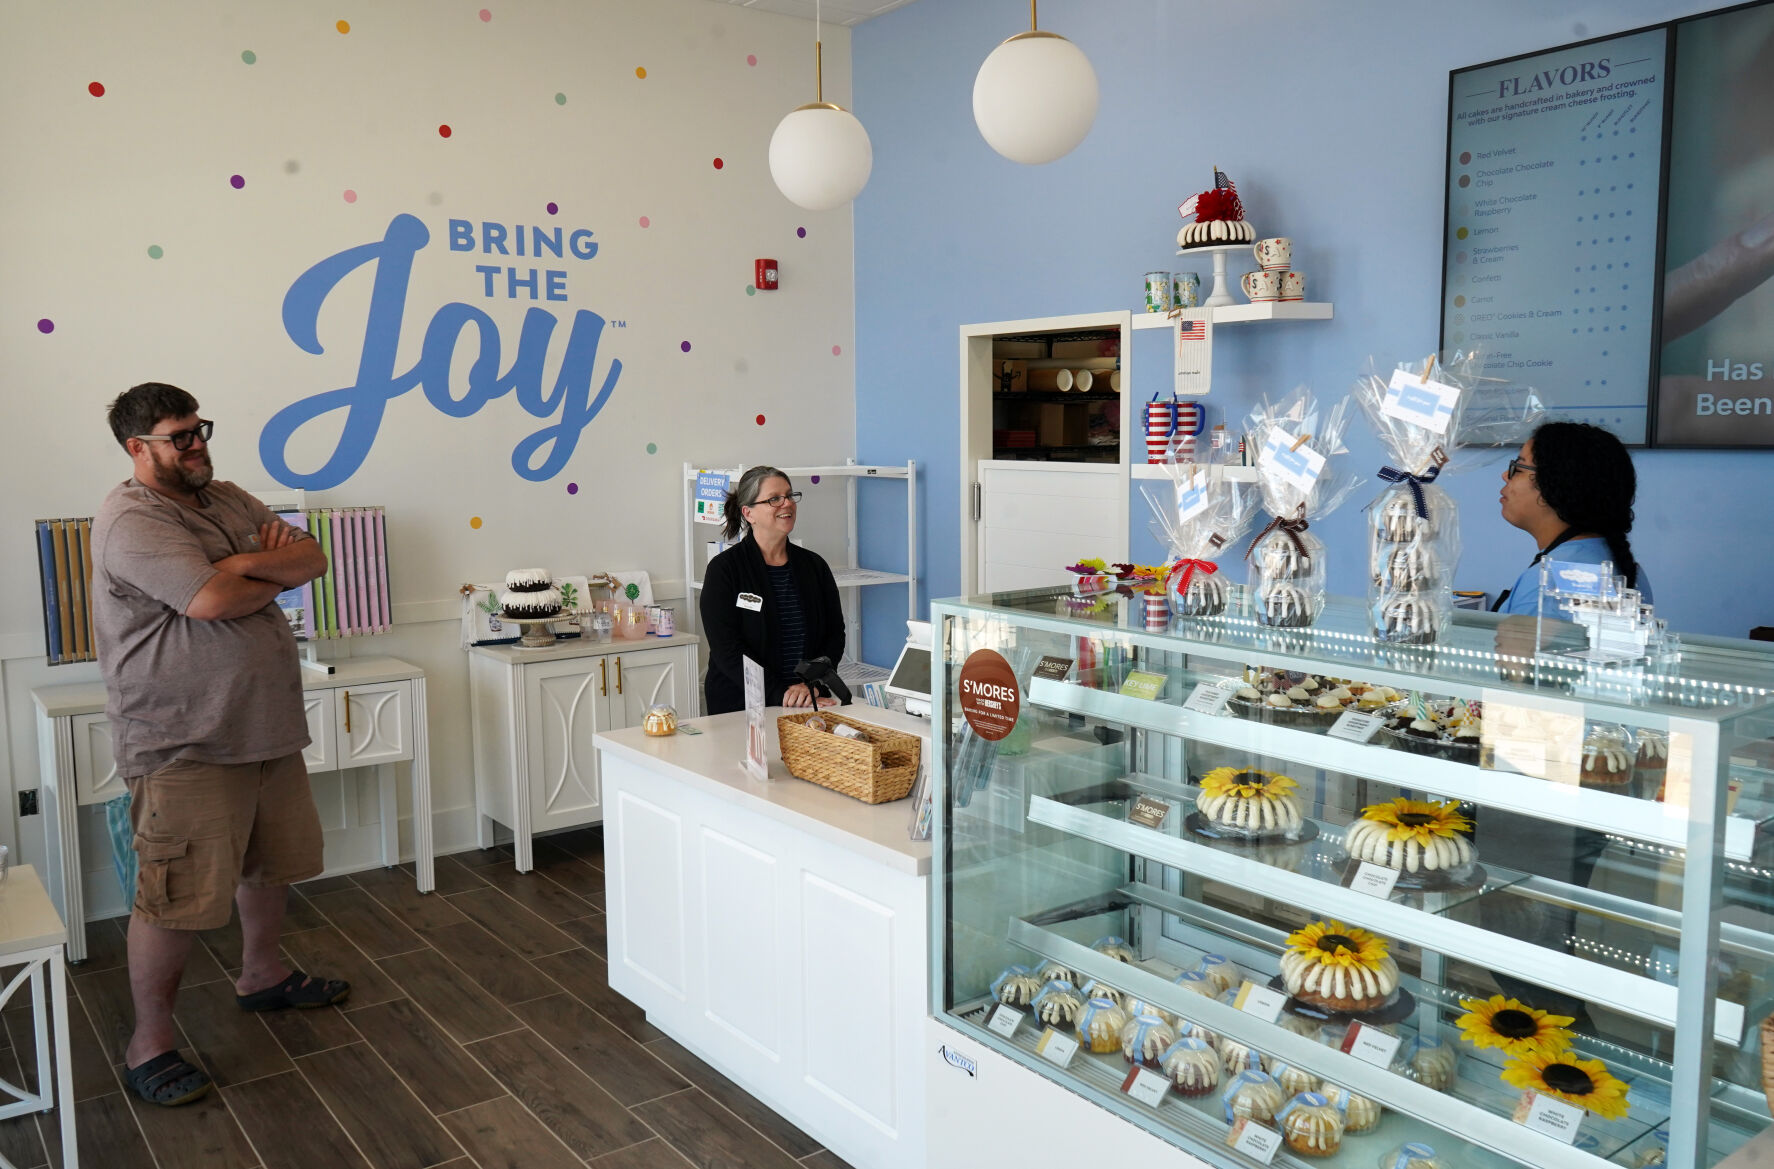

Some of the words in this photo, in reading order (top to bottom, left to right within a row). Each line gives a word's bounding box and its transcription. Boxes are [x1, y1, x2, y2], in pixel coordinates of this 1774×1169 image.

[1497, 58, 1611, 99] FLAVORS
[1456, 112, 1467, 120] All
[1468, 108, 1489, 118] cakes
[1491, 105, 1503, 113] are
[1504, 95, 1554, 111] handcrafted
[1555, 93, 1564, 101] in
[1565, 87, 1595, 100] bakery
[1596, 83, 1613, 93] and
[1615, 74, 1656, 90] crowned
[1467, 116, 1486, 126] with
[1487, 114, 1500, 122] our
[1502, 108, 1539, 121] signature
[1541, 103, 1567, 113] cream
[1567, 96, 1599, 108] cheese
[1599, 89, 1637, 102] frosting.
[1476, 152, 1492, 160] Red
[1493, 147, 1517, 157] Velvet
[1476, 167, 1514, 178] Chocolate
[1515, 160, 1555, 172] Chocolate
[1475, 179, 1494, 189] Chip
[1475, 198, 1497, 208] White
[1498, 193, 1538, 205] Chocolate
[1474, 207, 1512, 217] Raspberry
[1473, 227, 1500, 236] Lemon
[449, 218, 599, 261] BRING
[1472, 244, 1521, 256] Strawberries
[1480, 256, 1505, 264] Cream
[475, 264, 569, 302] THE
[1471, 274, 1502, 283] Confetti
[1497, 311, 1528, 321] Cookies
[1536, 310, 1562, 318] Cream
[1495, 330, 1520, 339] Vanilla
[258, 213, 623, 492] Joy
[1506, 360, 1525, 369] Chip
[1525, 360, 1554, 368] Cookie
[1707, 358, 1764, 381] Has
[1696, 393, 1772, 416] Been
[699, 476, 726, 487] DELIVERY
[700, 488, 722, 498] ORDERS
[1039, 660, 1069, 671] S'MORES
[963, 679, 1015, 703] S'MORES
[1125, 679, 1139, 688] KEY
[1139, 682, 1159, 691] LIME
[1135, 803, 1166, 818] S'MORES
